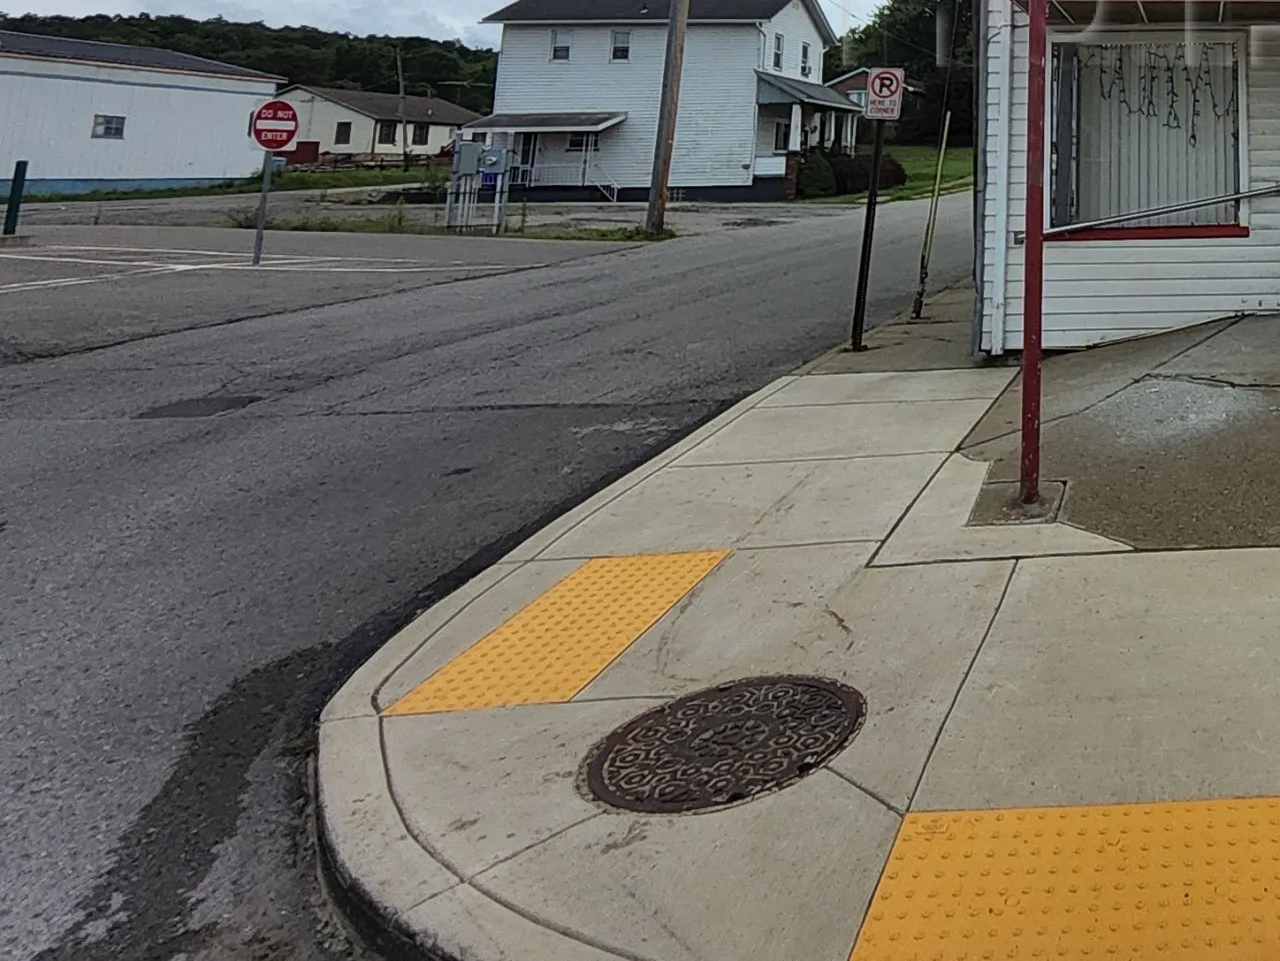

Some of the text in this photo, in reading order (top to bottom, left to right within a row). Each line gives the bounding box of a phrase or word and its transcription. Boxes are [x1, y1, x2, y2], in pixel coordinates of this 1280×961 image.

[889, 99, 897, 107] TO
[261, 109, 293, 119] DO NOT
[261, 131, 288, 141] ENTER
